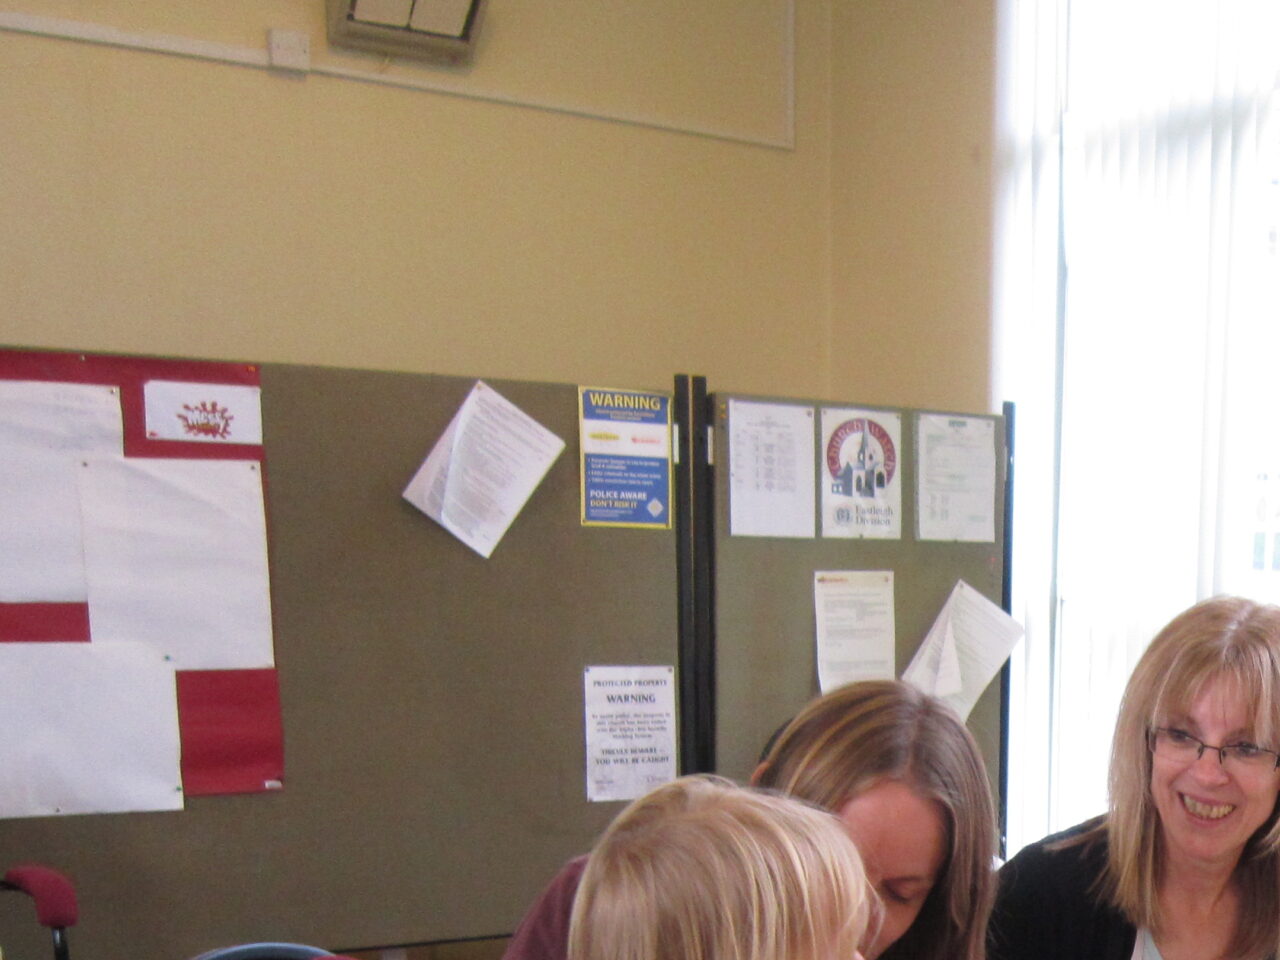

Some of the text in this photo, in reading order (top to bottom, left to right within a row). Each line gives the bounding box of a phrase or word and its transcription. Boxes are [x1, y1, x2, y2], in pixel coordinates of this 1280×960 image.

[589, 392, 661, 410] WARNING
[590, 490, 647, 501] POLICE AWARE
[855, 505, 894, 517] Eastleigh
[855, 516, 891, 526] Division
[634, 679, 668, 687] PROPERTY
[606, 693, 656, 704] WARNING
